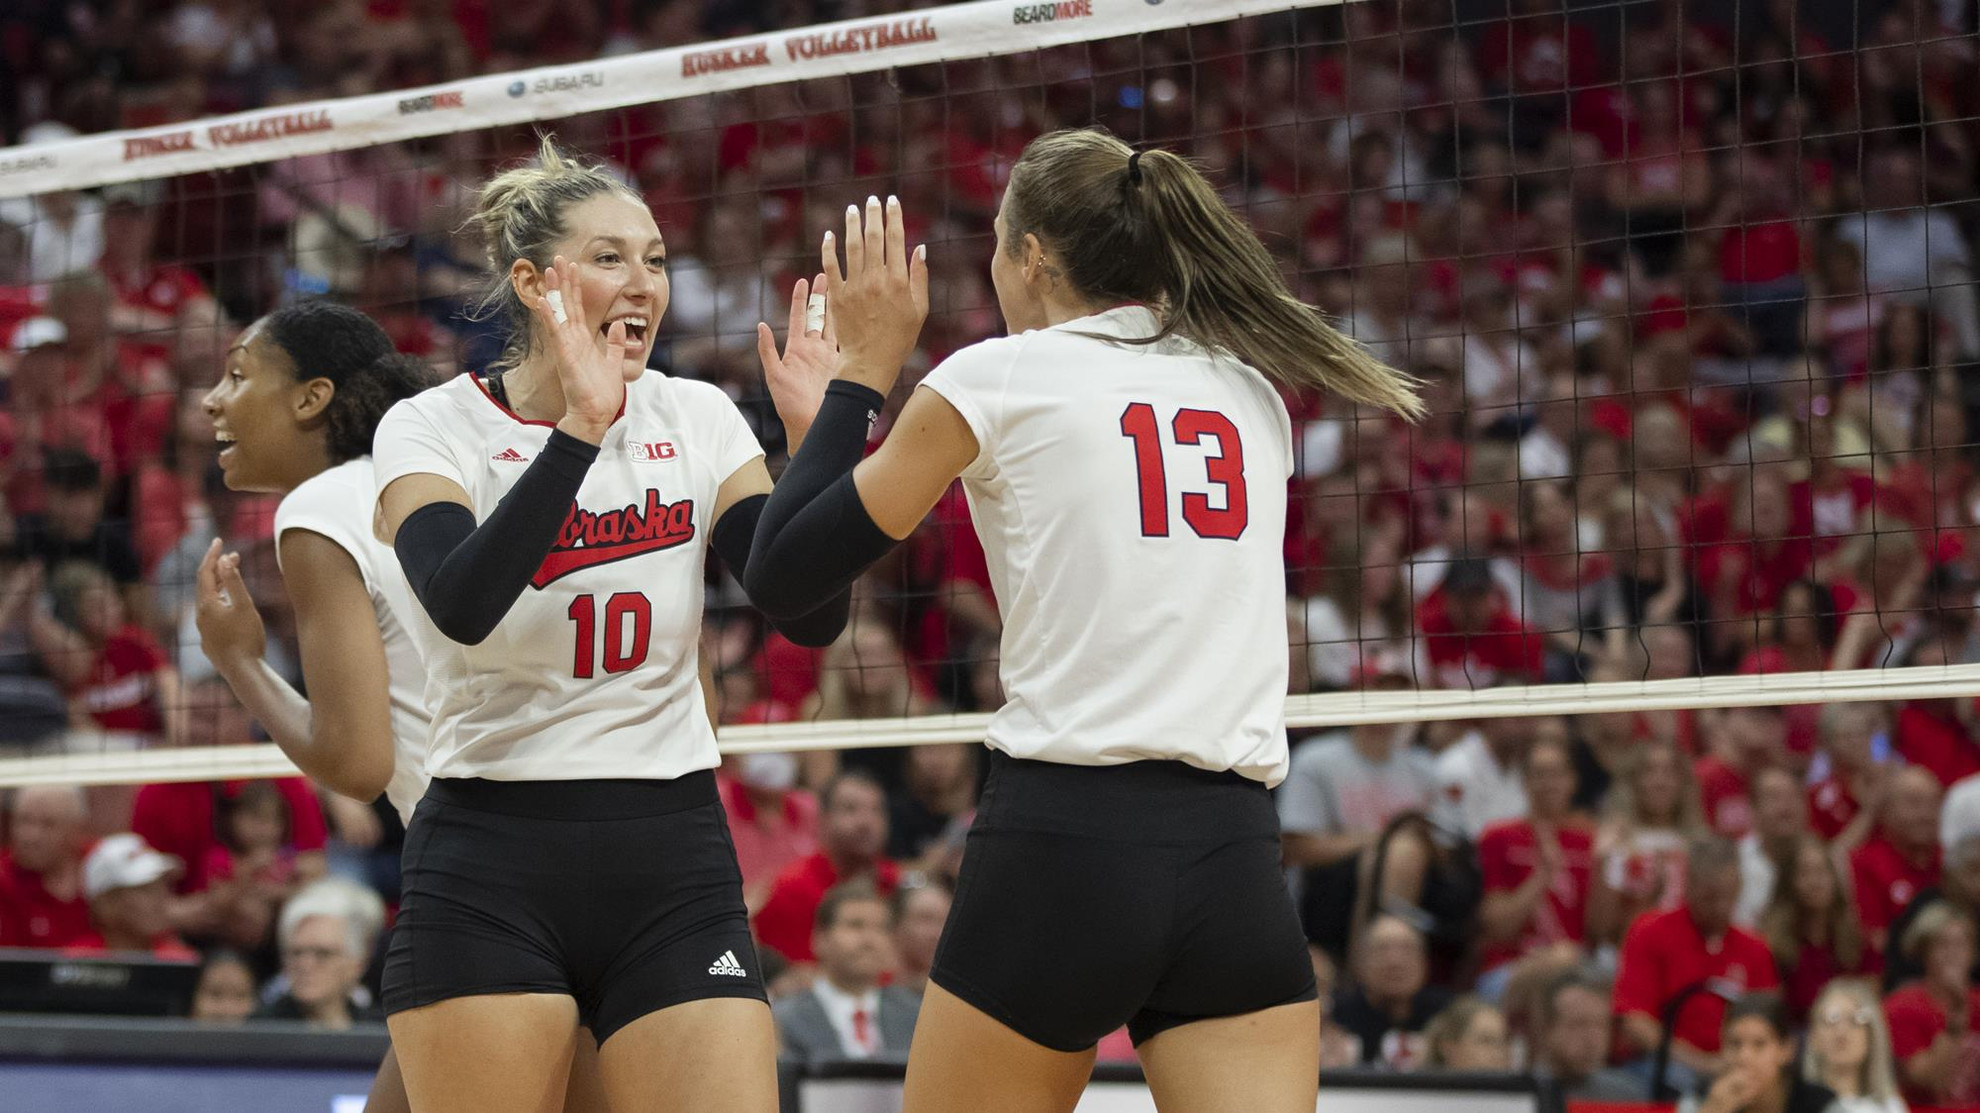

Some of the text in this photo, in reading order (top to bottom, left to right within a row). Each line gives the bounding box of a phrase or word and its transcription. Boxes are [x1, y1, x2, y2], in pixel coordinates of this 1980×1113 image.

[1013, 0, 1093, 24] BEARDMORE
[681, 17, 937, 78] HUSKER VOLLEYBALL
[533, 74, 604, 94] SUBARU
[1120, 402, 1248, 541] 13
[553, 488, 695, 548] braska
[568, 592, 651, 679] 10
[708, 965, 747, 977] adidas
